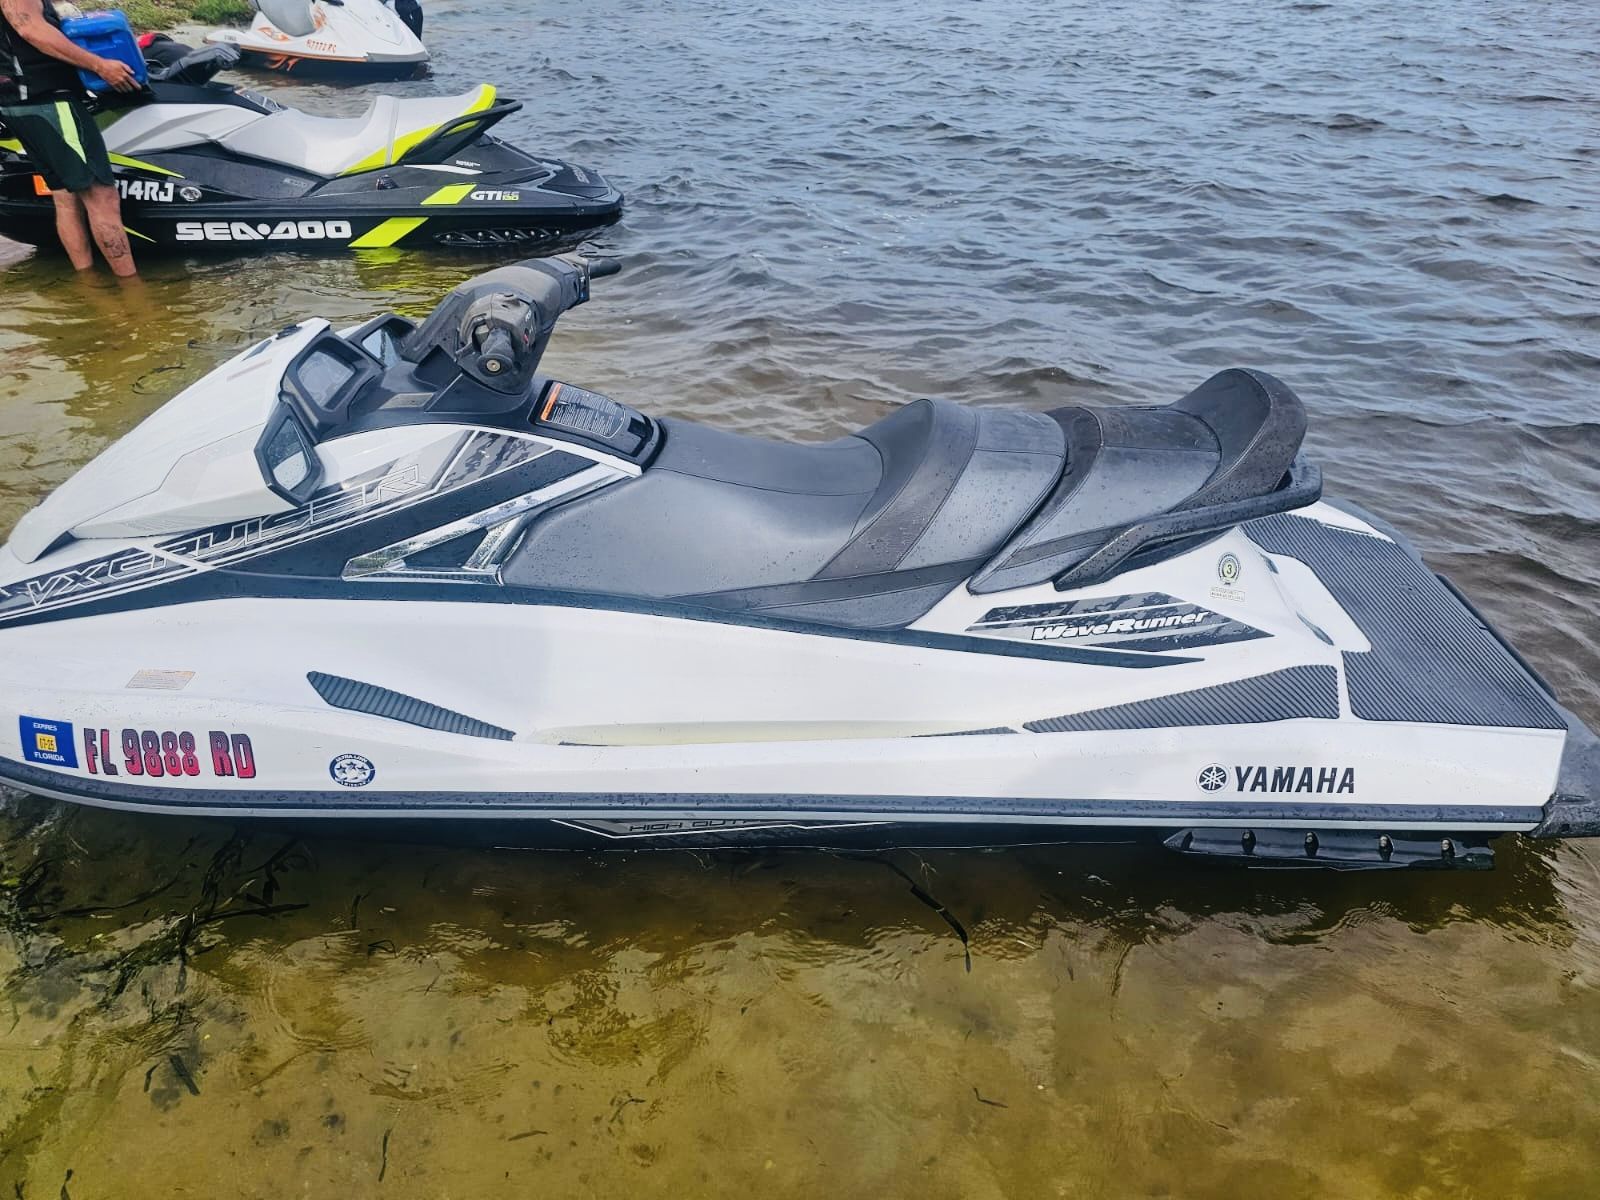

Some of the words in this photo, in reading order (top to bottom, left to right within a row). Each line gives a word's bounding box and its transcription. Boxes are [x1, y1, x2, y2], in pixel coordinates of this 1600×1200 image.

[114, 180, 174, 202] 14RJ
[27, 565, 104, 608] VX
[1032, 611, 1210, 640] WaveRunner
[33, 751, 66, 762] FLORIDA
[83, 727, 119, 776] FL
[121, 728, 201, 777] 9888
[208, 730, 256, 778] RD
[1235, 766, 1355, 793] YAMAHA
[629, 822, 683, 832] HIGH
